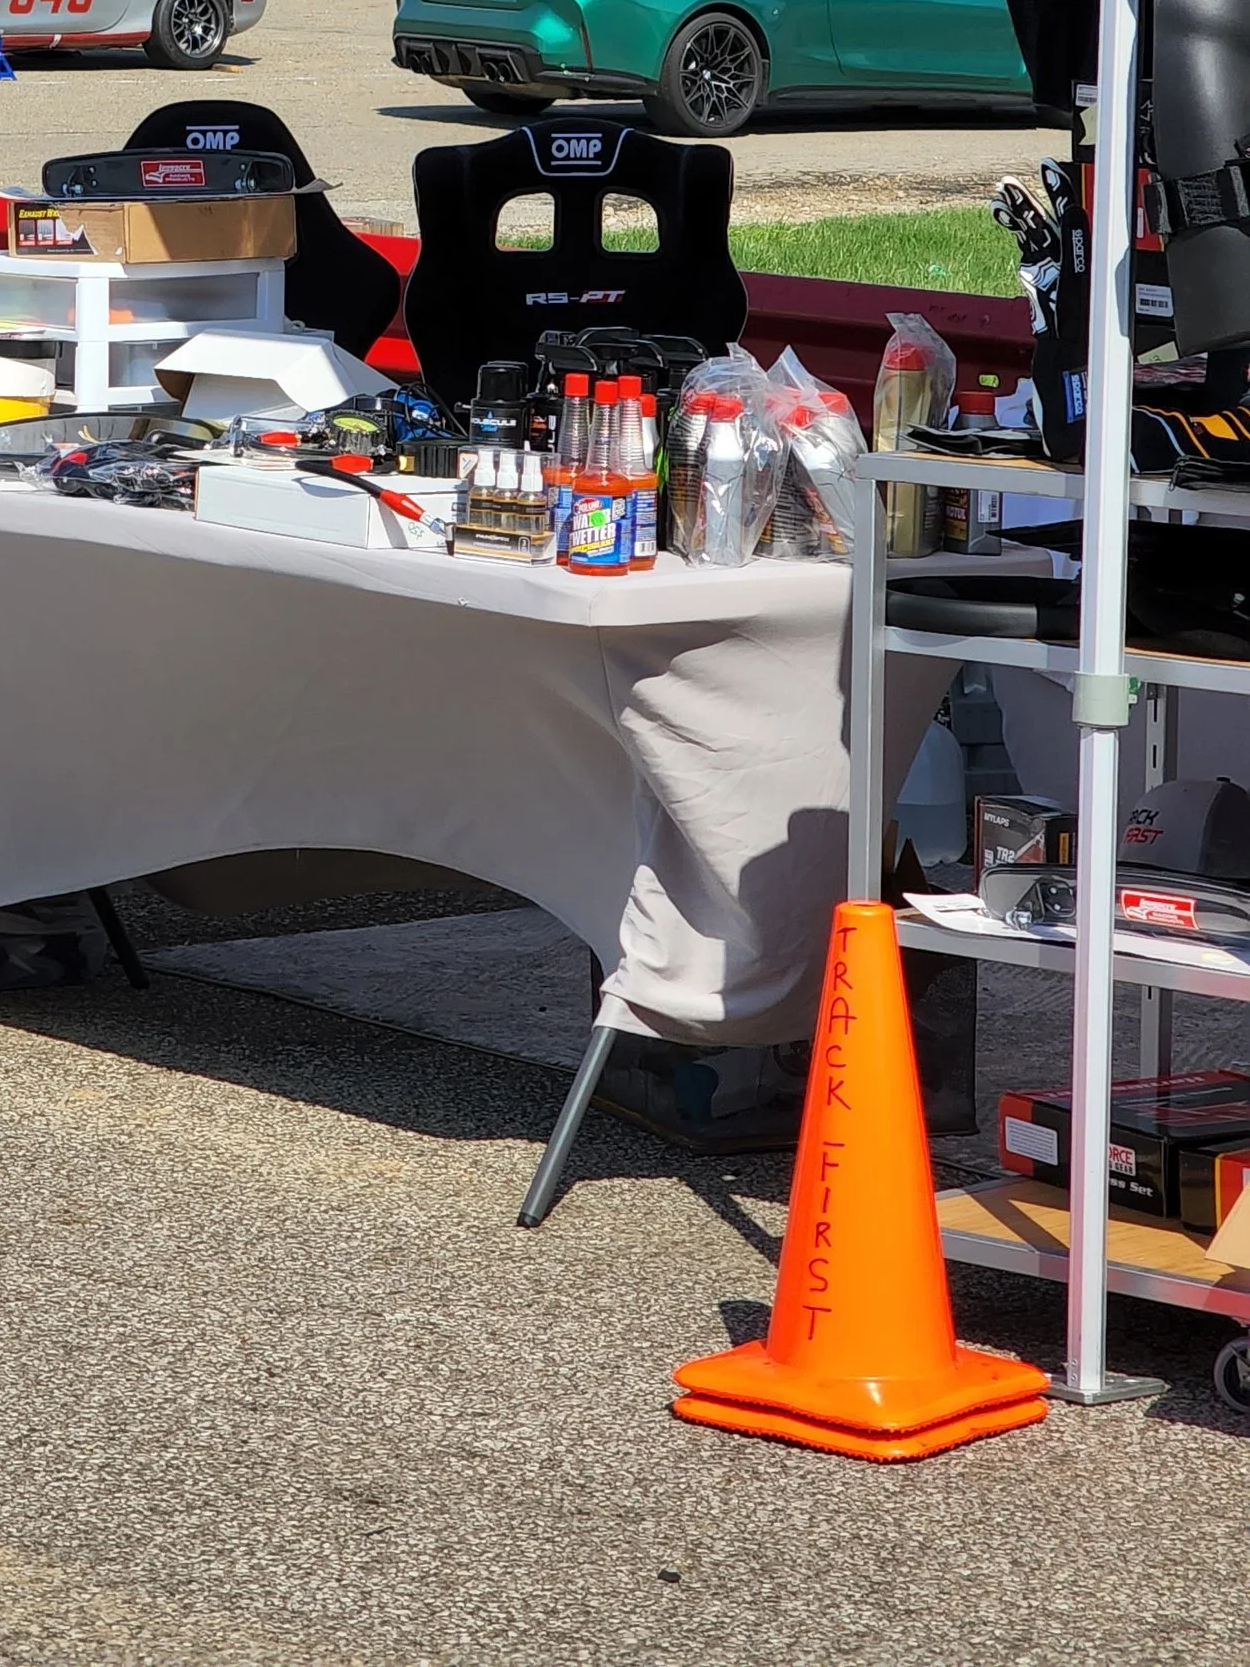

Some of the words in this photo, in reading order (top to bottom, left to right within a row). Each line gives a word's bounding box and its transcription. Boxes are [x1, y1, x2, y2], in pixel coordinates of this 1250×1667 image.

[186, 131, 240, 150] OMP
[551, 138, 602, 159] OMP
[1075, 229, 1086, 273] sparco
[1071, 374, 1084, 416] sparco
[571, 522, 617, 548] WETTER
[983, 812, 1011, 828] MYLAPS
[996, 845, 1016, 864] TR2
[826, 927, 858, 1111] TRACK
[1129, 1182, 1154, 1197] Set
[802, 1141, 845, 1340] FIRST
